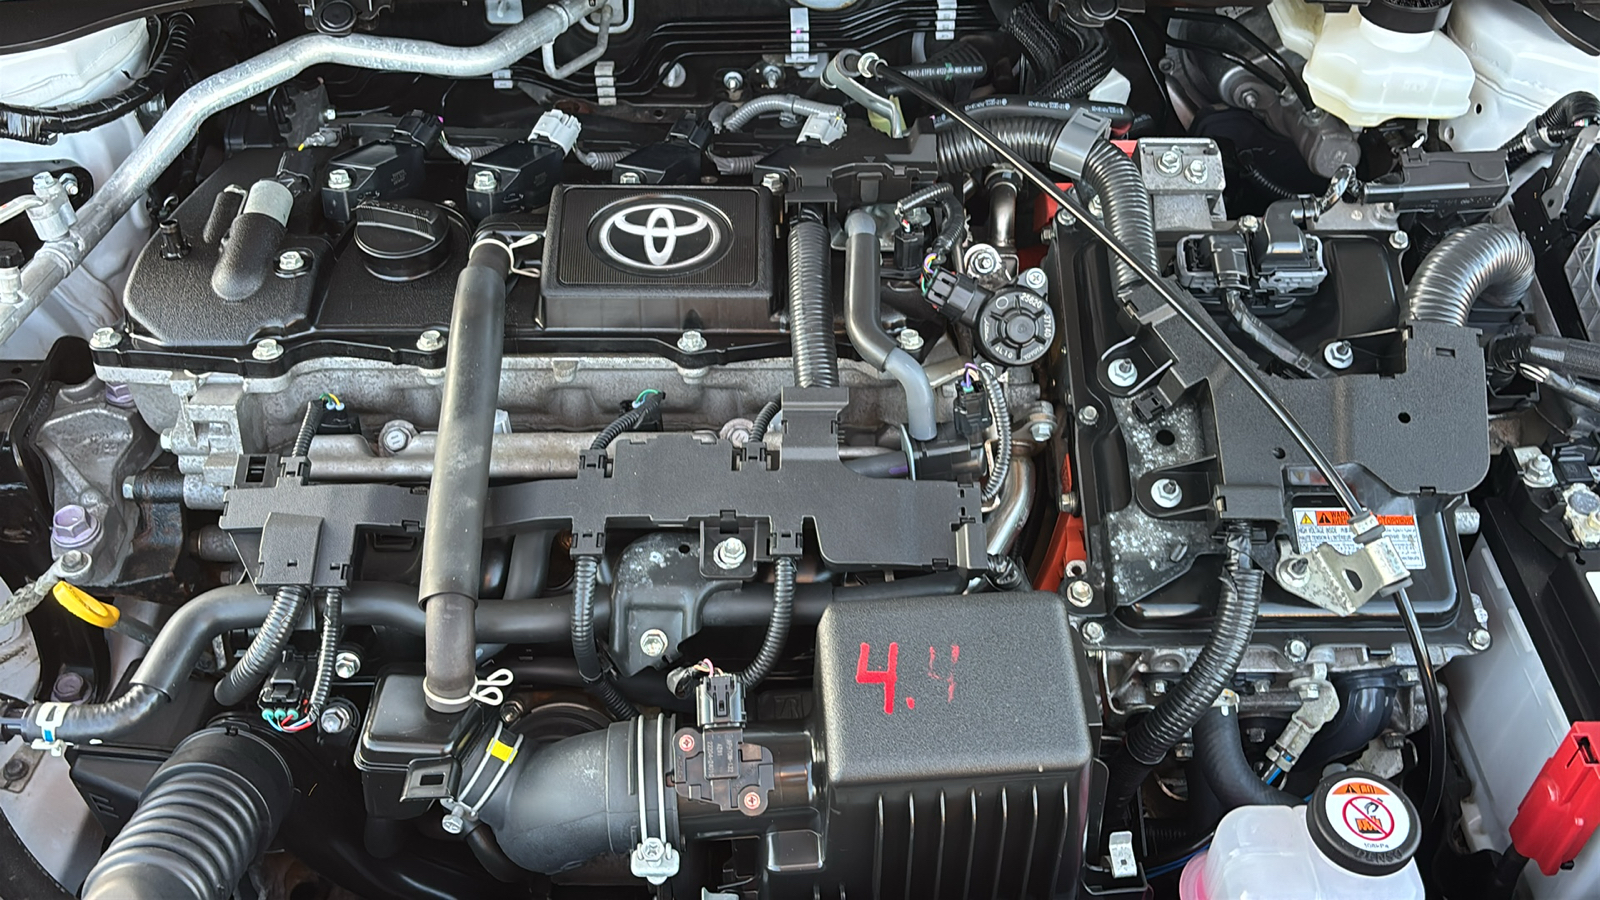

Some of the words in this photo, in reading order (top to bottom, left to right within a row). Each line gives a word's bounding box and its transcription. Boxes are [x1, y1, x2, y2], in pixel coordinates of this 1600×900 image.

[1020, 292, 1043, 309] 25620
[1043, 314, 1052, 338] 37140
[1023, 346, 1044, 361] TOYOTA
[1356, 849, 1403, 864] DENSO
